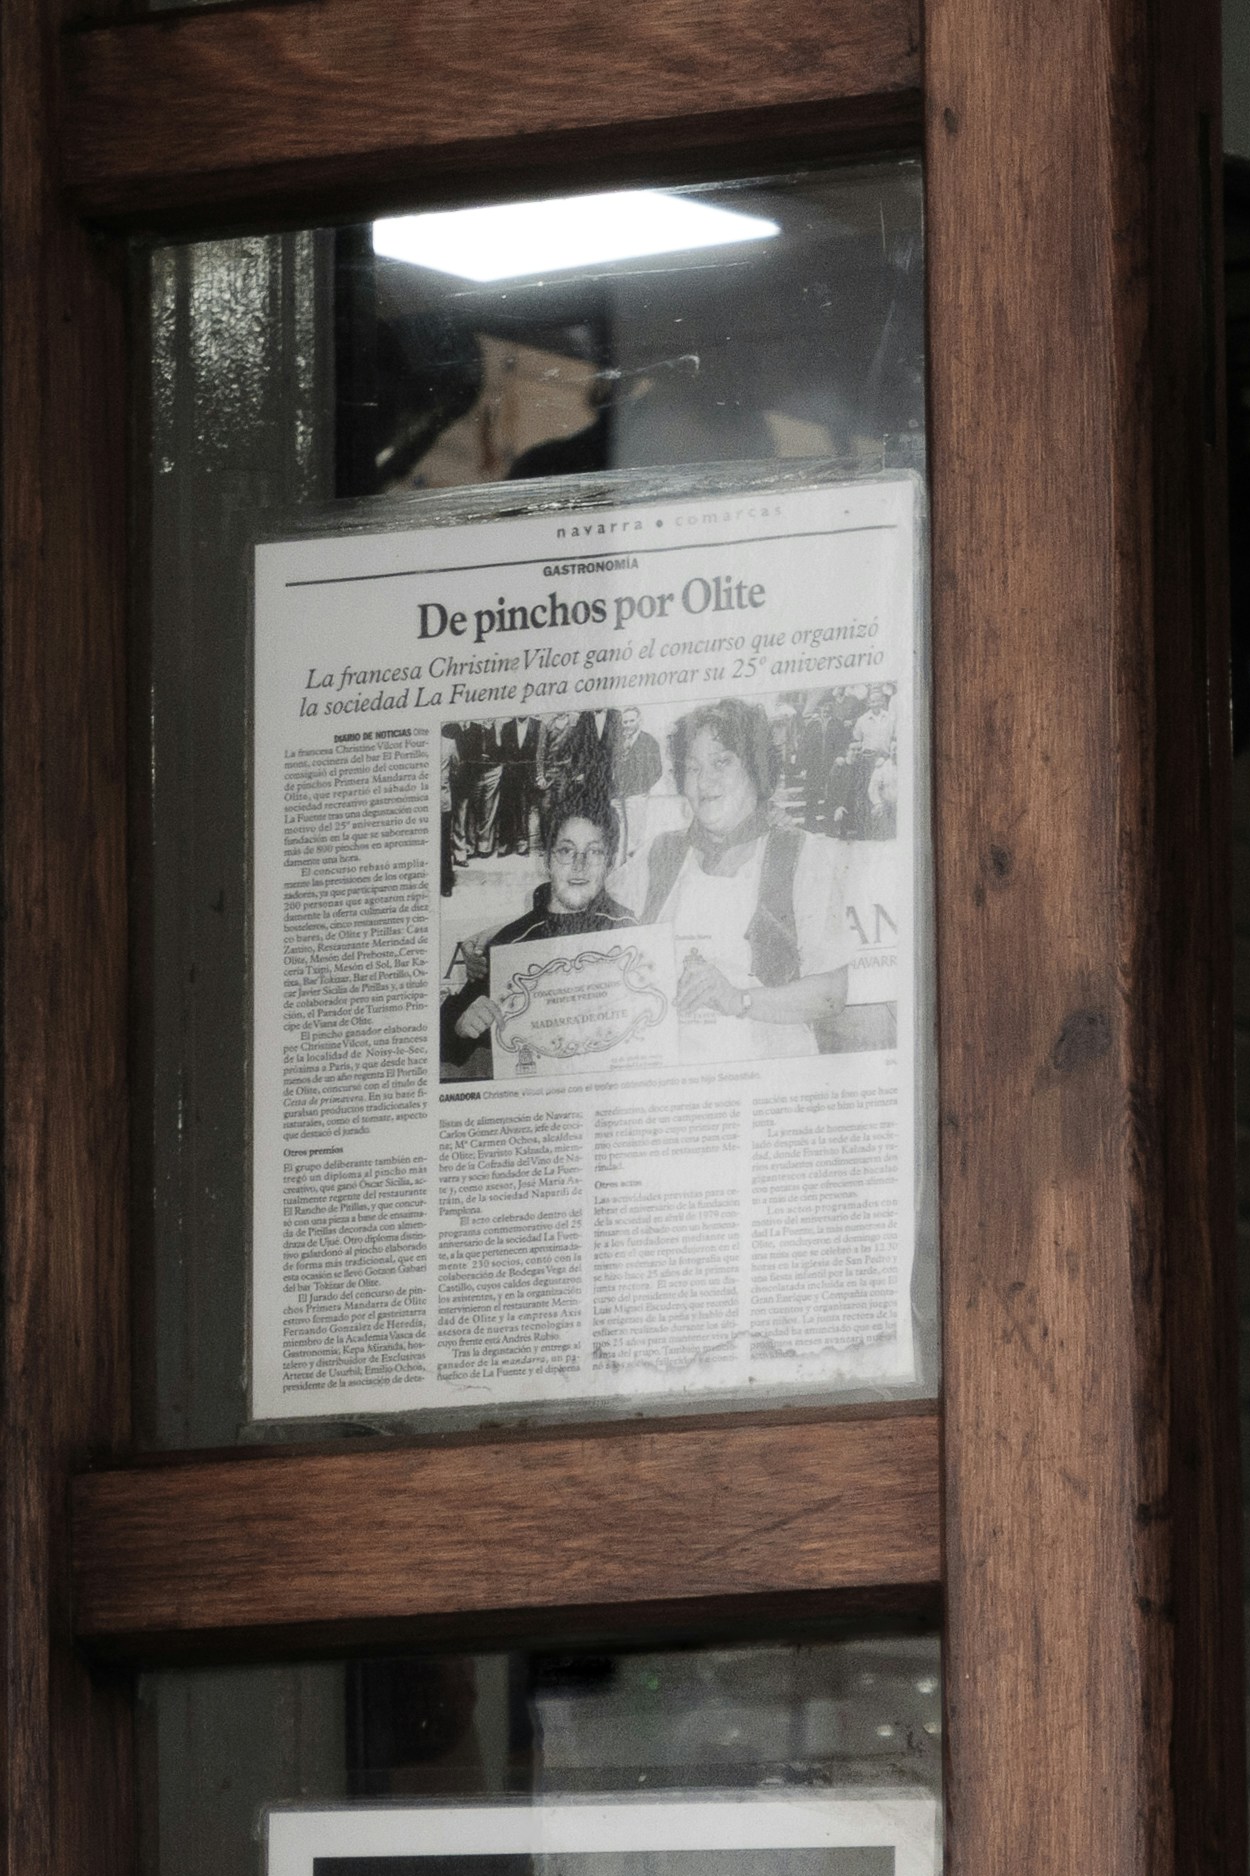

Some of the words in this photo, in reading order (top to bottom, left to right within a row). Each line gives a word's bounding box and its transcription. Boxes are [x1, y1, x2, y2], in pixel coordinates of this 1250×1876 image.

[555, 519, 643, 540] navarra
[674, 505, 781, 527] comarcas
[541, 557, 638, 577] GASTRONOMÍA
[416, 601, 468, 640] De
[472, 590, 607, 644] pinchos
[612, 592, 674, 631] por
[680, 574, 765, 614] Olite
[303, 667, 335, 690] La
[335, 664, 422, 692] francesa
[427, 651, 520, 679] Christine
[522, 646, 580, 670] Vilcot
[582, 639, 632, 670] ganó
[638, 637, 655, 659] el
[659, 635, 745, 657] concurso
[750, 631, 785, 654] que
[790, 615, 878, 648] organizó
[298, 695, 319, 718] la
[322, 686, 410, 716] sociedad
[412, 685, 442, 708] La
[447, 682, 517, 705] Fuente
[519, 679, 568, 704] para
[573, 668, 699, 694] conmemorar
[703, 666, 725, 681] su
[731, 656, 766, 678] 25º
[769, 644, 884, 675] aniversario
[334, 734, 361, 743] DIARIO
[363, 733, 372, 741] DE
[375, 729, 411, 739] NOTICIAS
[413, 728, 429, 736] Olite
[439, 1091, 480, 1102] GANADORA
